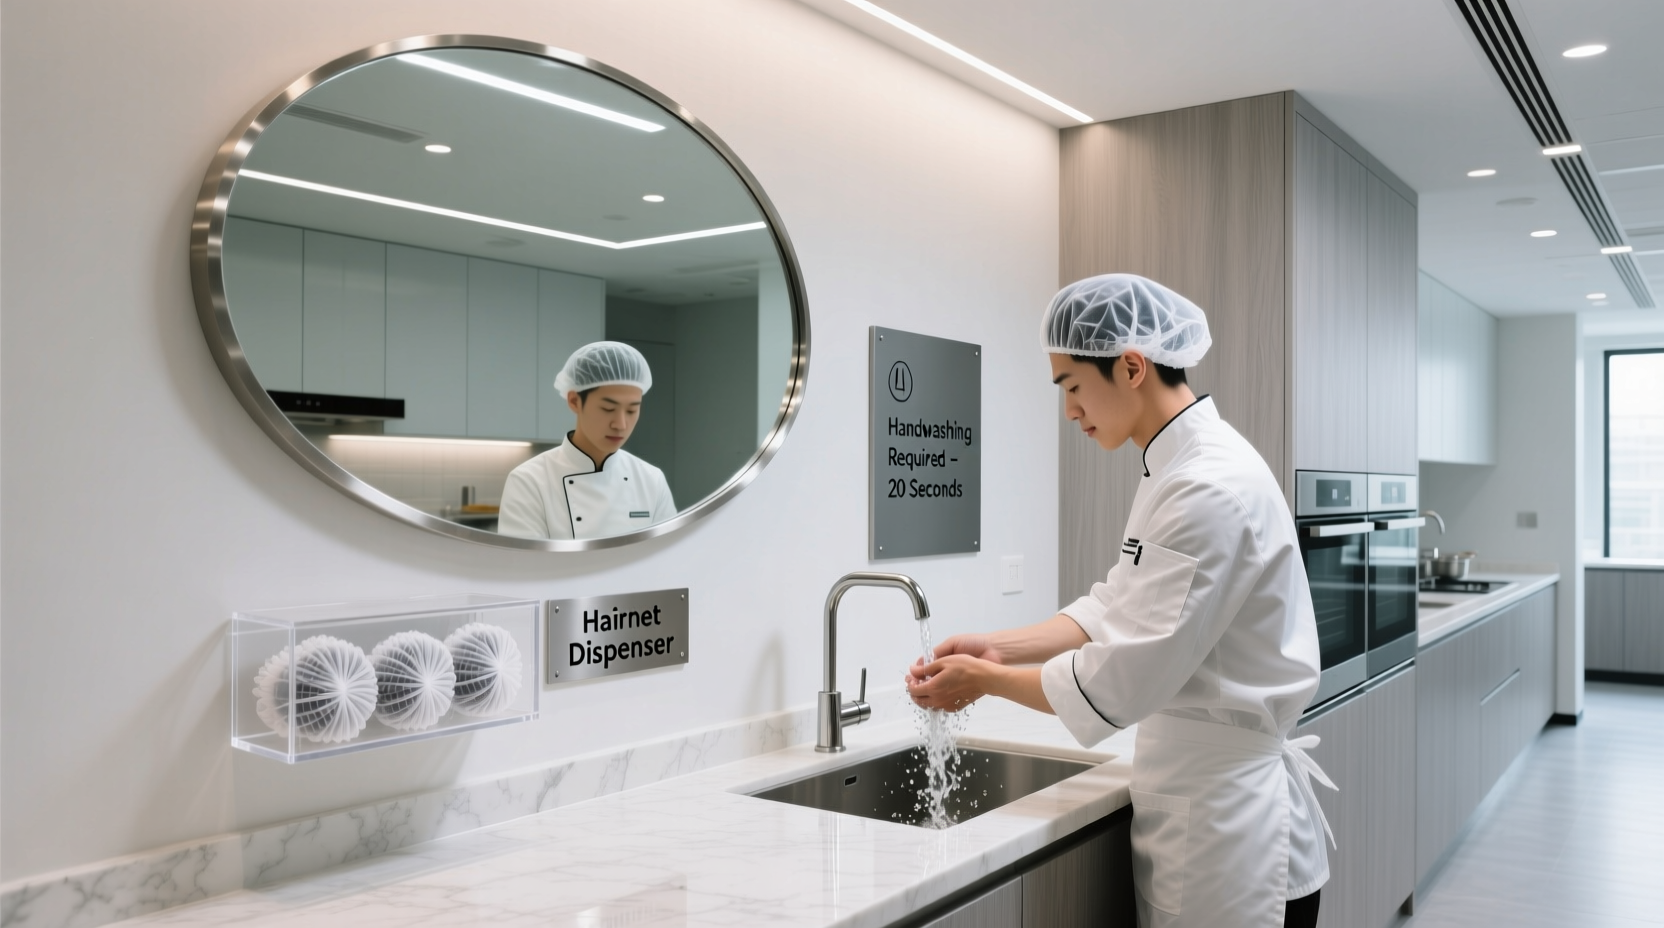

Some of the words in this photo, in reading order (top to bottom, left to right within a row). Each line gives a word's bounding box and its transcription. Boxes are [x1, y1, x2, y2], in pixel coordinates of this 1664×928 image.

[888, 417, 972, 446] Handwashing
[888, 447, 946, 471] Required
[888, 478, 906, 498] 20
[909, 478, 963, 498] Seconds
[583, 605, 661, 633] Hairnet
[569, 636, 675, 669] Dispenser
